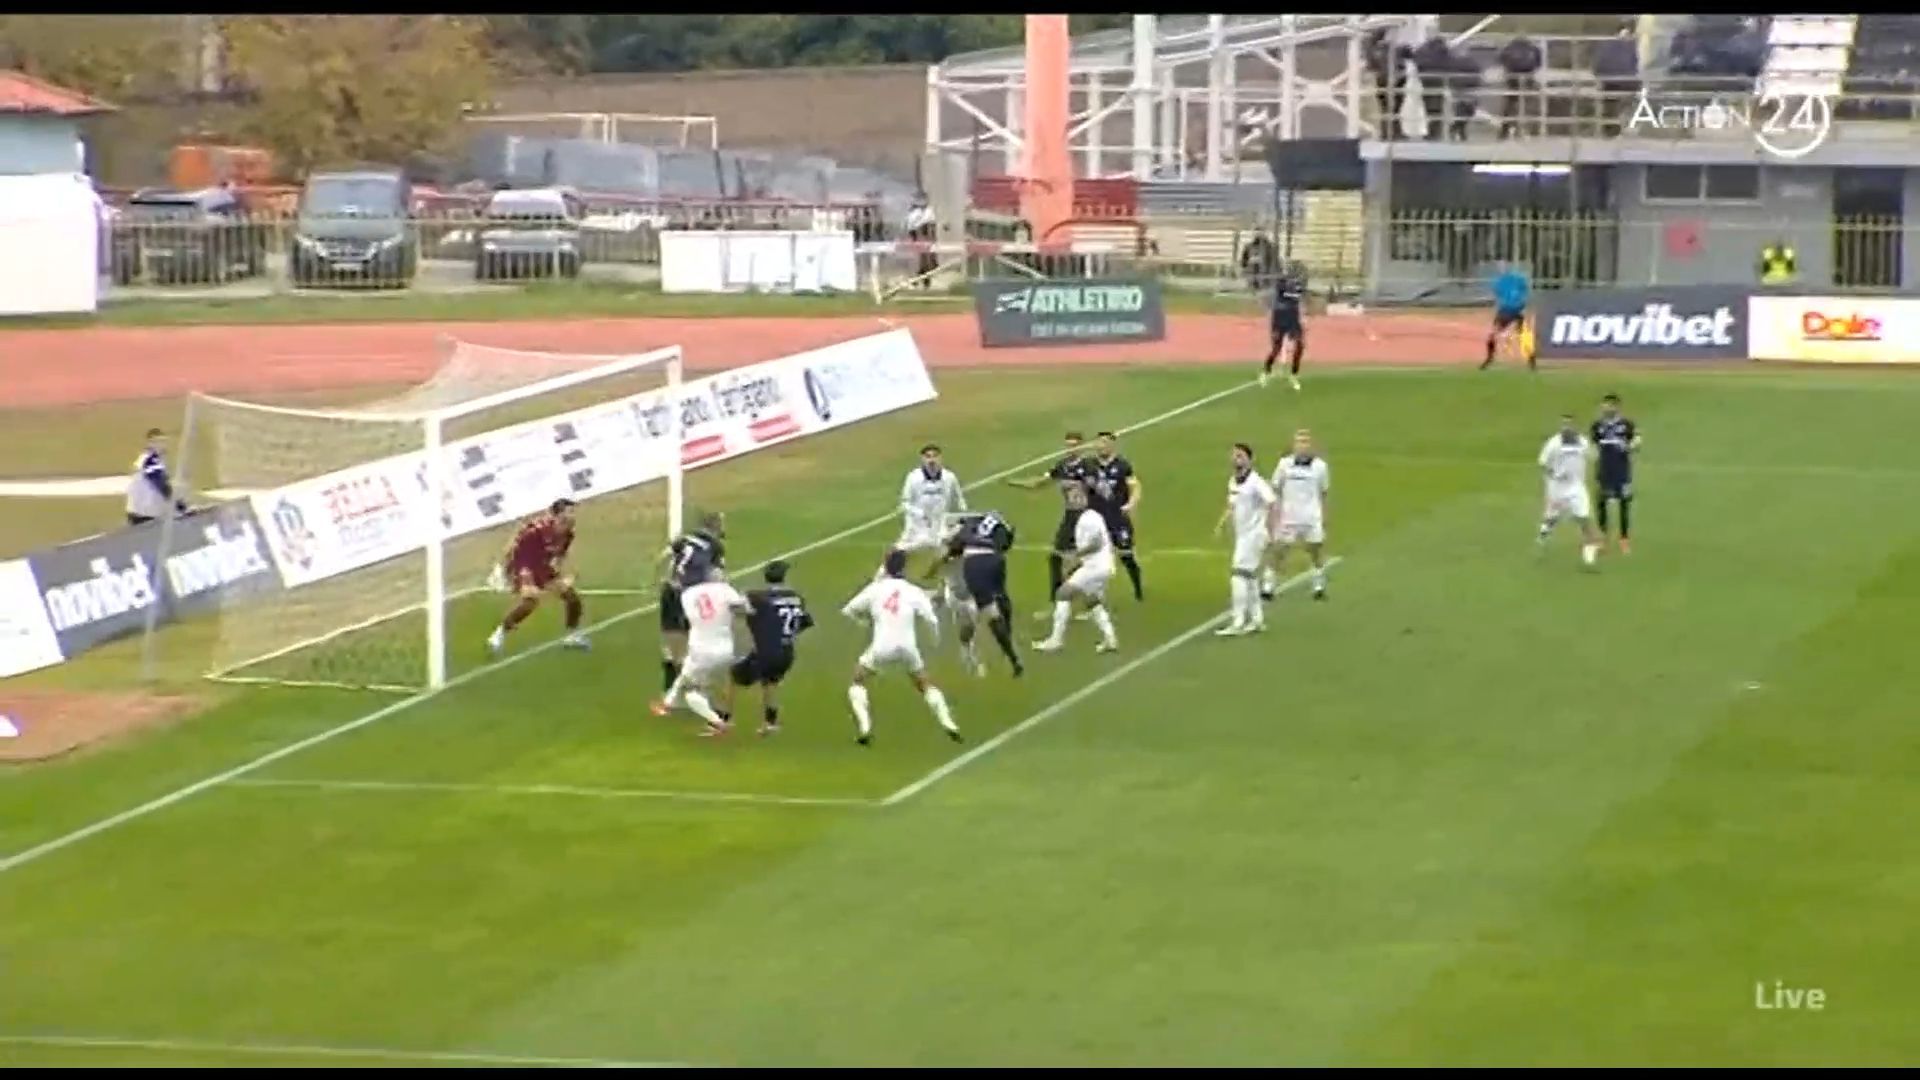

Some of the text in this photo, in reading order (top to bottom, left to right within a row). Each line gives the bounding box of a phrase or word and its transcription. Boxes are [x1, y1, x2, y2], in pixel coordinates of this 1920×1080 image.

[1551, 303, 1735, 346] novibet
[45, 552, 157, 632] novibet
[883, 588, 901, 616] 4
